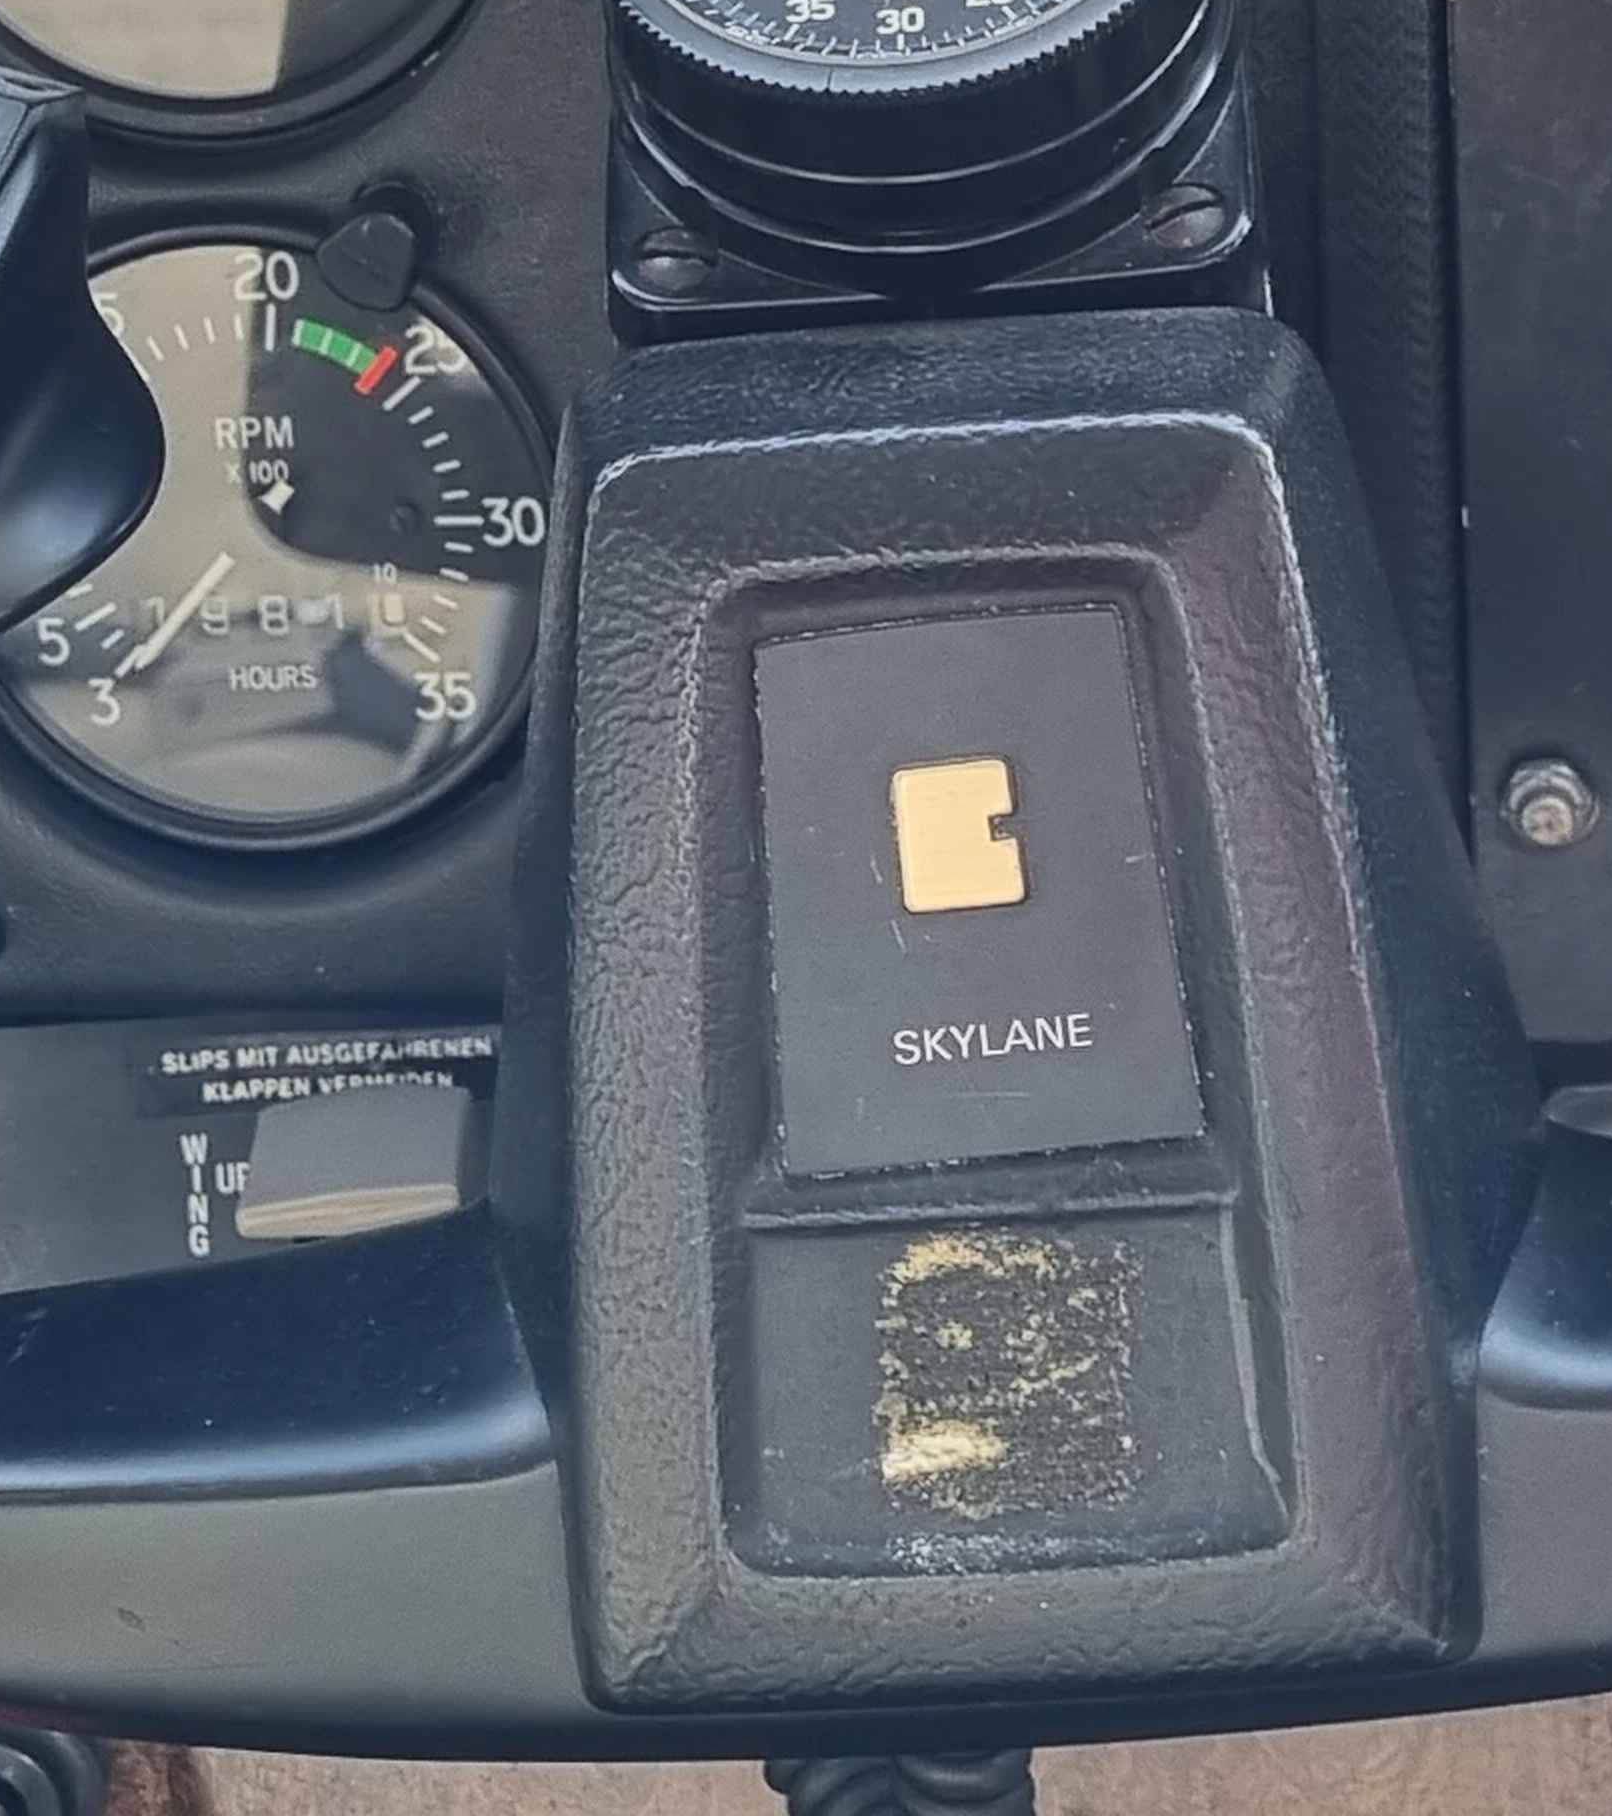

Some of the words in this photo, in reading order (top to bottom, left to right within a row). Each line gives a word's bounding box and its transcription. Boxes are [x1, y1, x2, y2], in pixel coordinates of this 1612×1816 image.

[876, 9, 925, 33] 30
[233, 251, 299, 301] 20
[215, 417, 294, 448] RPM
[482, 497, 544, 546] 30
[230, 666, 316, 691] HOURS
[414, 672, 475, 720] 35
[893, 1014, 1094, 1066] SKYLANE
[161, 1049, 229, 1074] SLIPS
[236, 1046, 276, 1068] MIT
[203, 1078, 311, 1104] KLAPPEN
